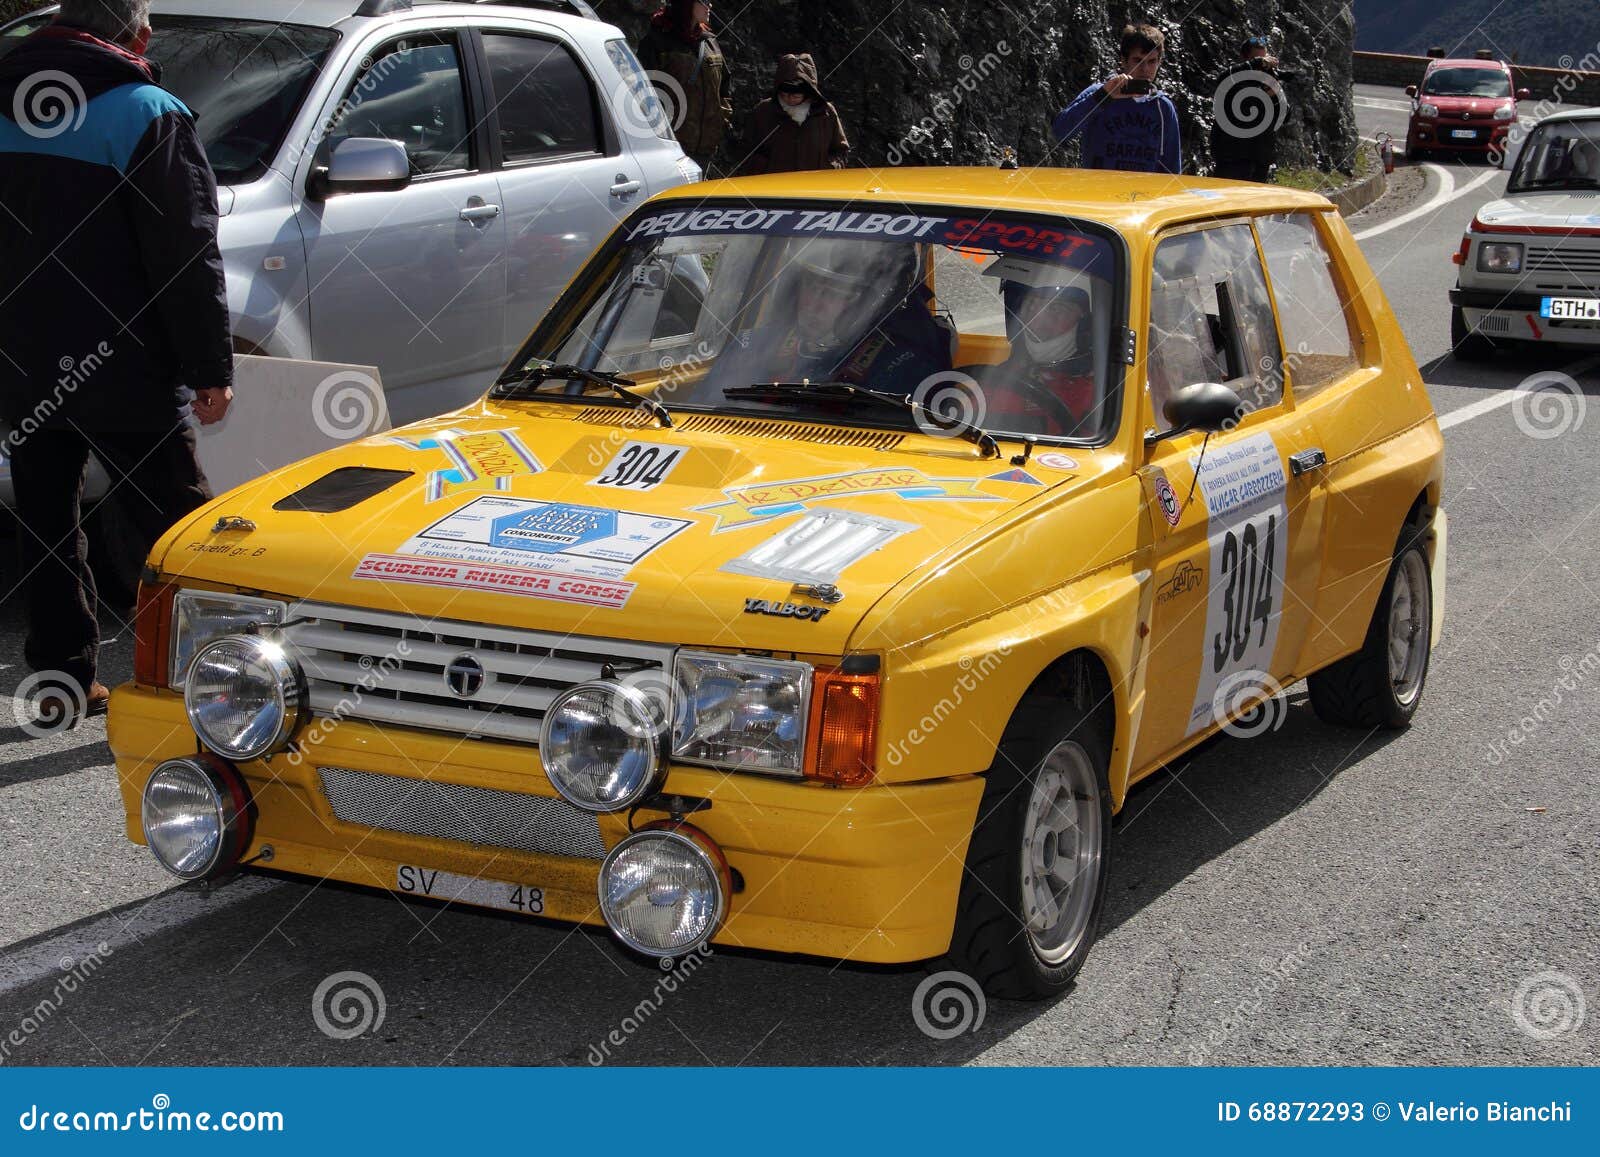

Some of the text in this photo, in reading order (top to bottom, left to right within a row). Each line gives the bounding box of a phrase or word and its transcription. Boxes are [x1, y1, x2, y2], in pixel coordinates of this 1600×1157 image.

[625, 209, 1096, 258] PEUGEOT TALBOT SPORT
[1552, 300, 1586, 317] GTH
[597, 445, 681, 489] 304
[779, 473, 921, 498] Delizie
[252, 547, 267, 557] B
[503, 528, 575, 543] CONCORRENTE
[358, 559, 630, 601] SCUDERIA RIVIERA CORSE
[1213, 514, 1276, 674] 304
[743, 597, 831, 622] TALBOT
[398, 865, 544, 914] SV 48
